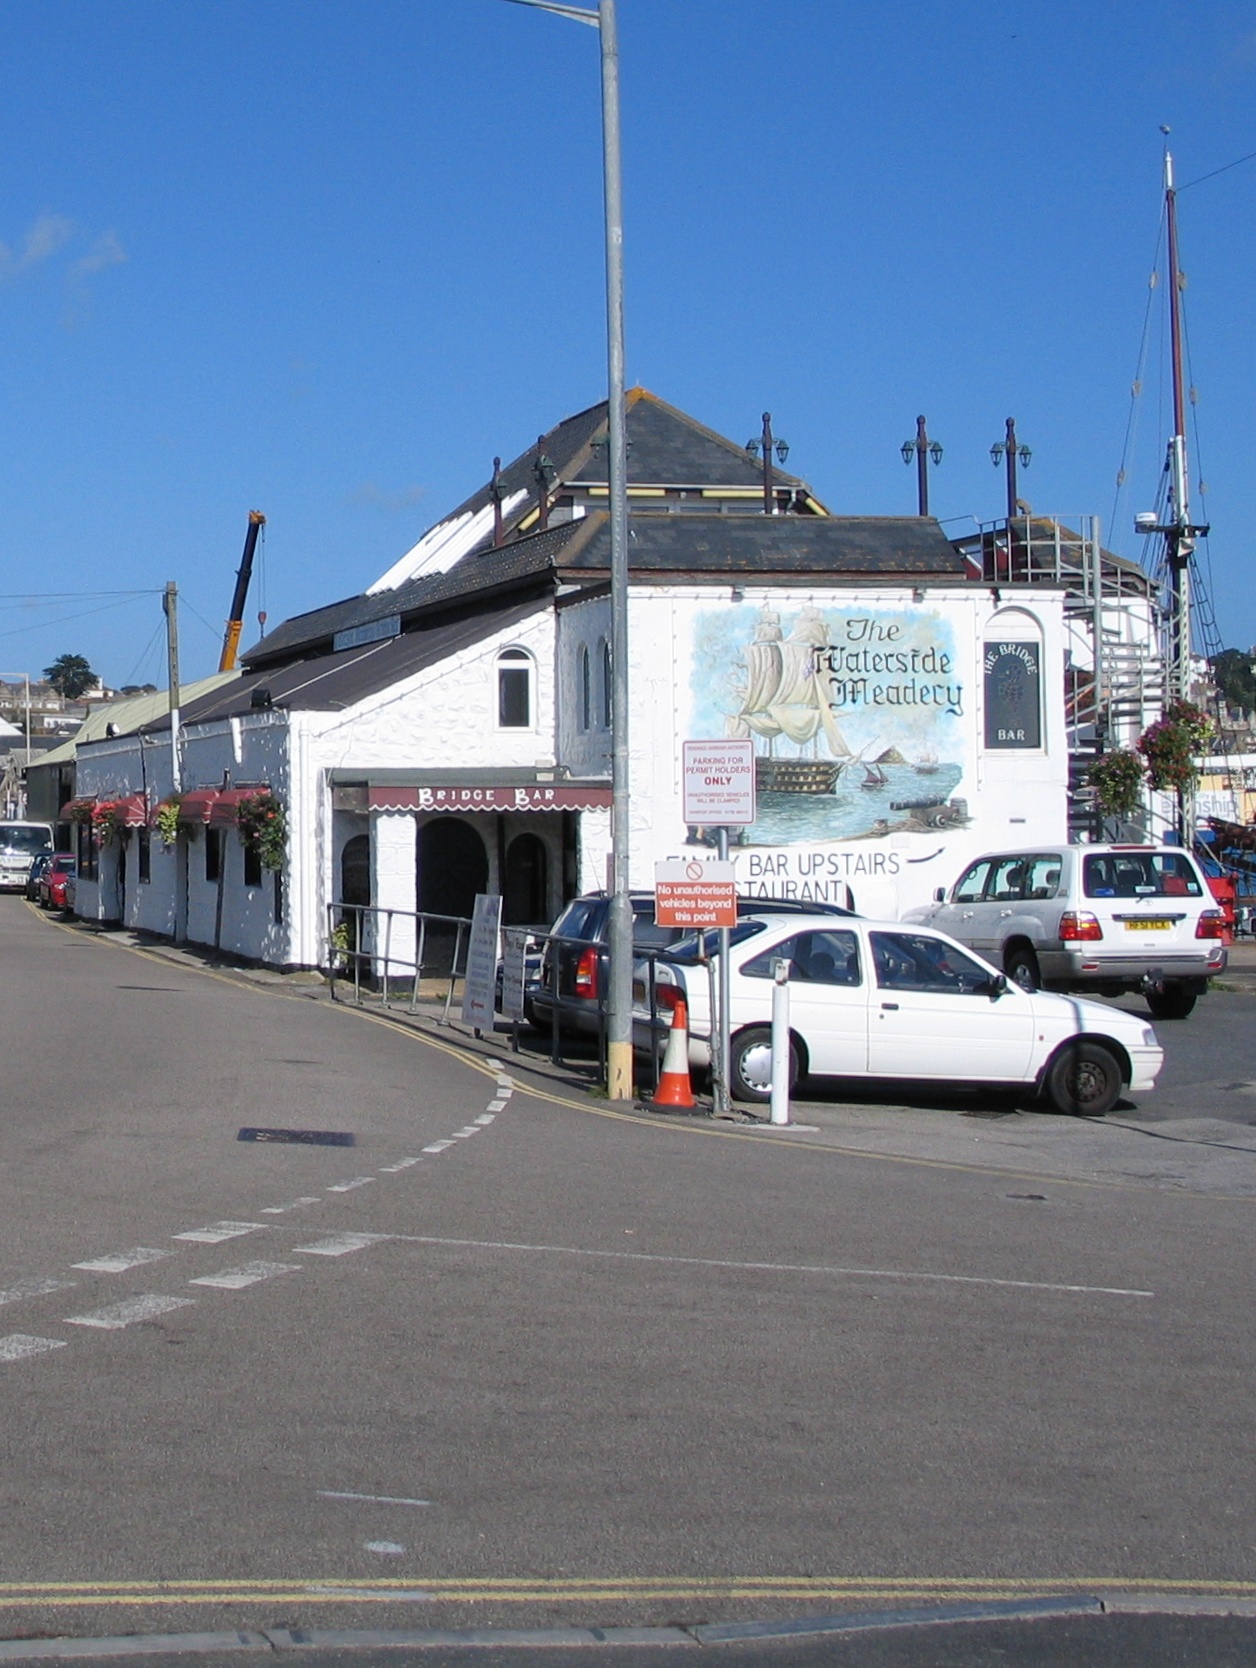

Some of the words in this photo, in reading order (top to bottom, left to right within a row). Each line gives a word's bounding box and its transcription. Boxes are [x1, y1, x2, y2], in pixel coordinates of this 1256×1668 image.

[846, 618, 904, 642] The
[813, 646, 953, 674] Waterside
[984, 650, 999, 675] THE
[999, 643, 1038, 675] BRIDGE
[829, 677, 964, 717] Meadery
[997, 729, 1025, 741] BAR
[692, 757, 726, 765] PARKING
[728, 756, 744, 764] FOR
[686, 766, 713, 774] PERMIT
[715, 765, 751, 774] HOLDERS
[704, 776, 732, 786] ONLY
[418, 787, 495, 805] BRIDGE
[514, 788, 555, 805] BAR
[749, 853, 790, 877] BAR
[798, 852, 900, 876] UPSTAIRS
[657, 885, 672, 895] No
[673, 885, 733, 895] unauthorised
[659, 898, 696, 908] vehicles
[697, 898, 732, 910] beyond
[674, 911, 692, 921] this
[693, 911, 718, 923] point
